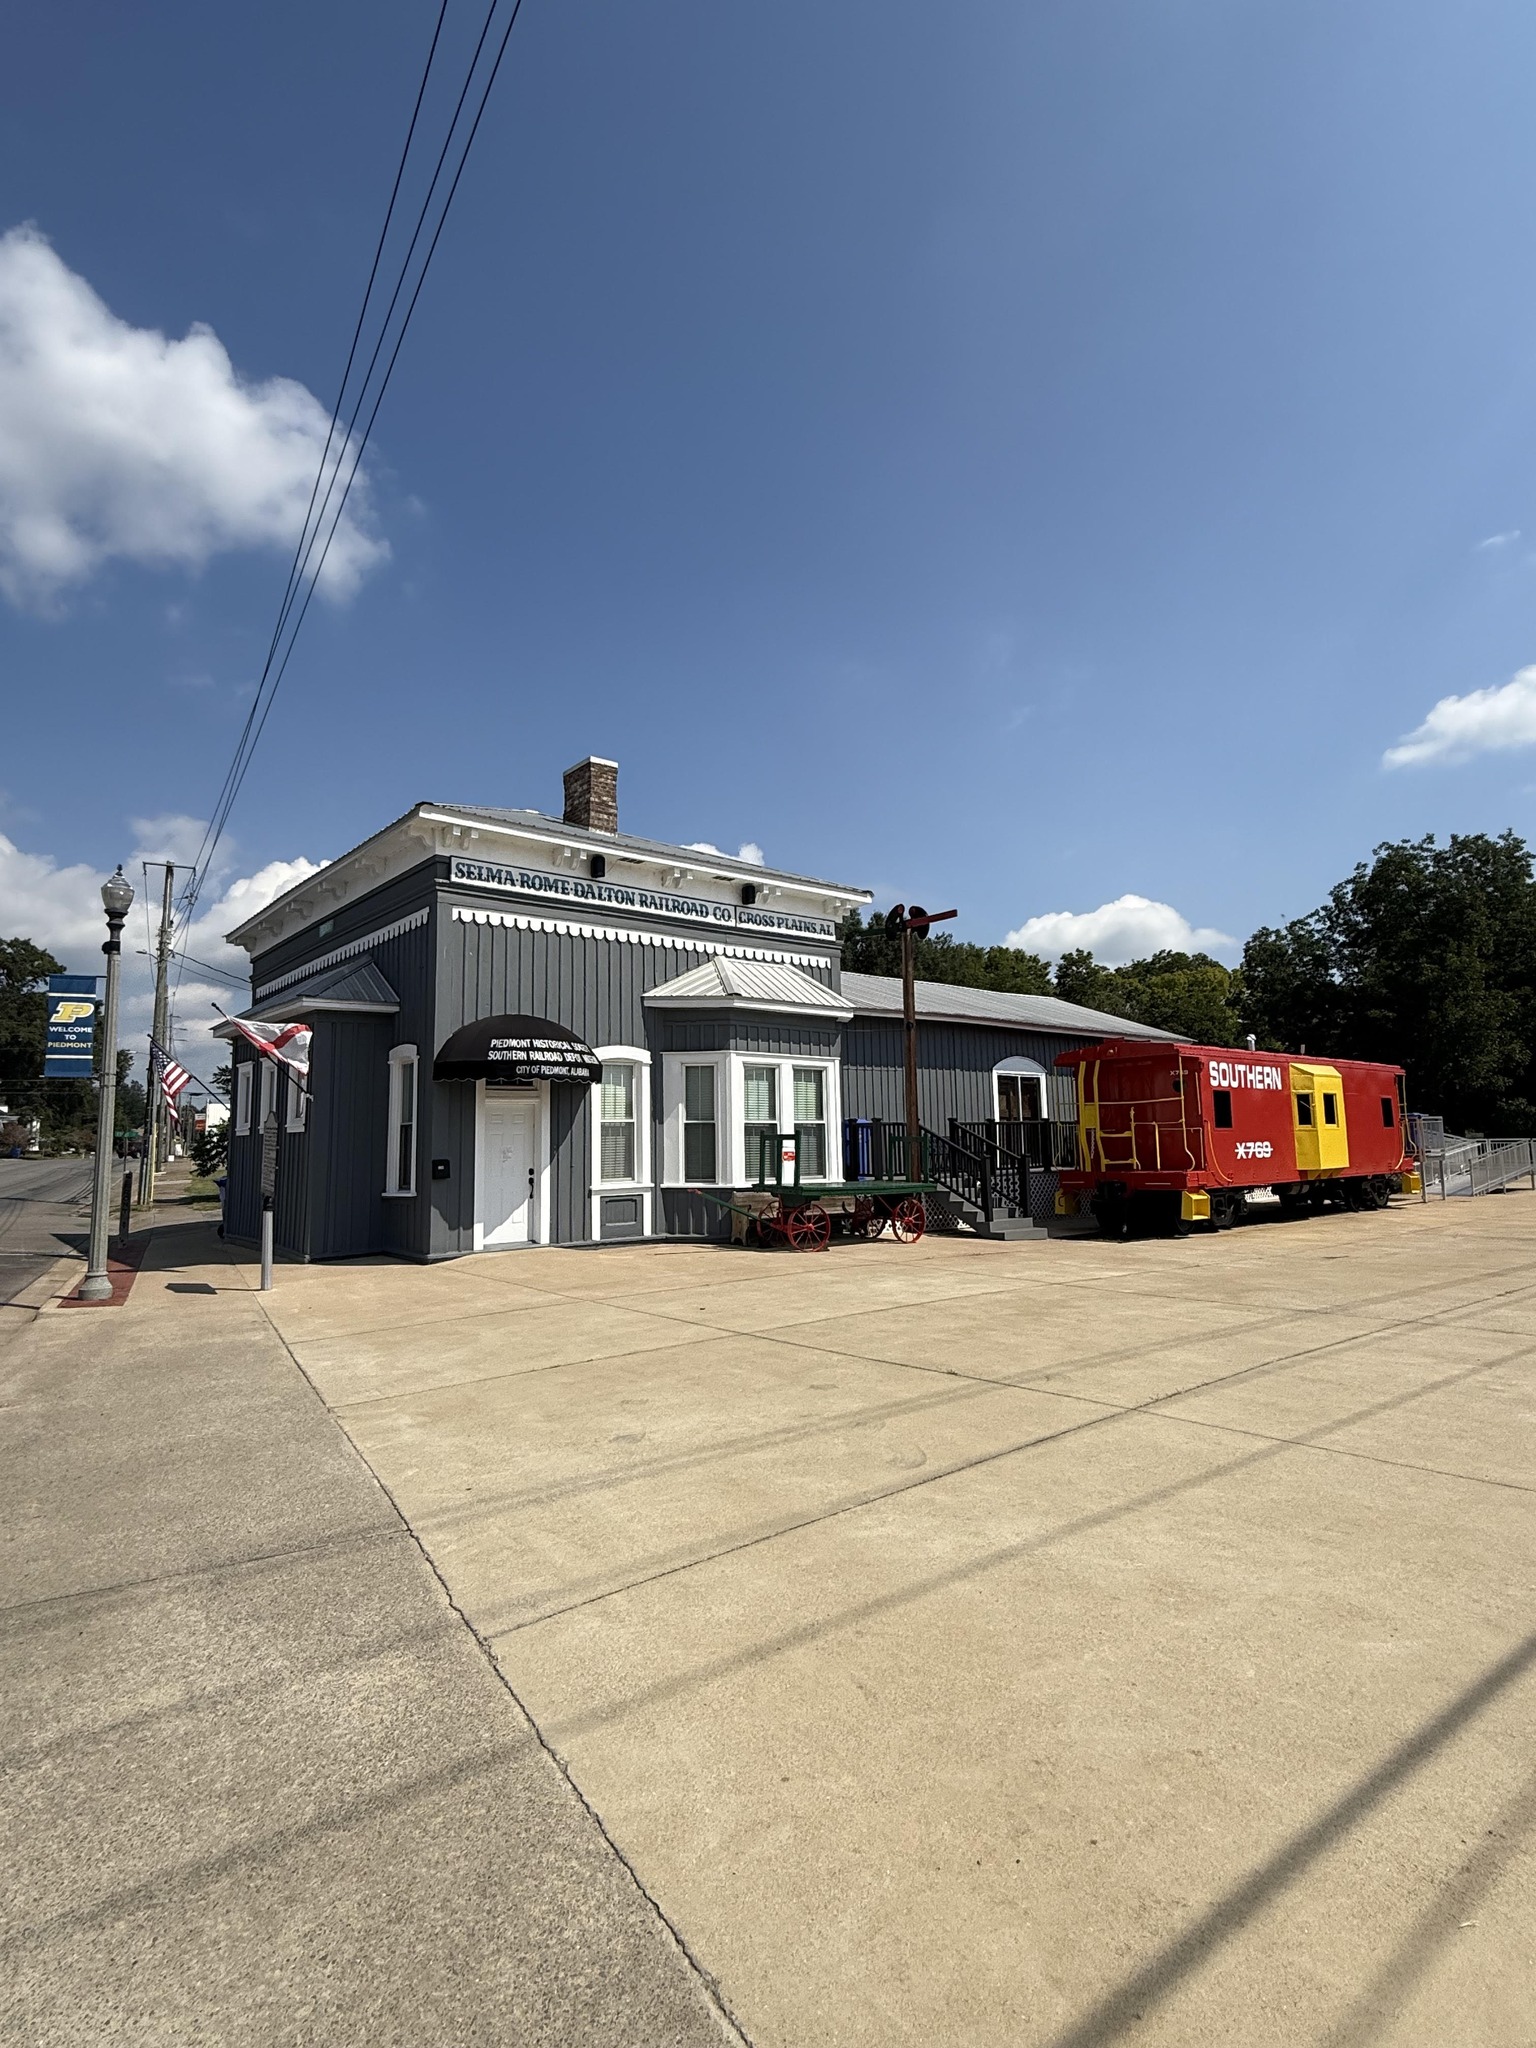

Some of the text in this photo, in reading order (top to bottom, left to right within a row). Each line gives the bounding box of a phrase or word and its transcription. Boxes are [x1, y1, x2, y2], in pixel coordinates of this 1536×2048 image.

[638, 893, 709, 918] RAILROAD
[738, 911, 775, 927] CROSS
[819, 923, 834, 937] AL
[50, 1002, 94, 1023] P
[490, 1038, 531, 1048] PIEDMONT
[532, 1039, 573, 1050] HISTORICAL
[487, 1050, 527, 1061] SOUTHERN
[528, 1051, 563, 1062] RAILROAD
[515, 1065, 531, 1074] CITY
[531, 1065, 540, 1074] OF
[1208, 1060, 1283, 1090] SOUTHERN
